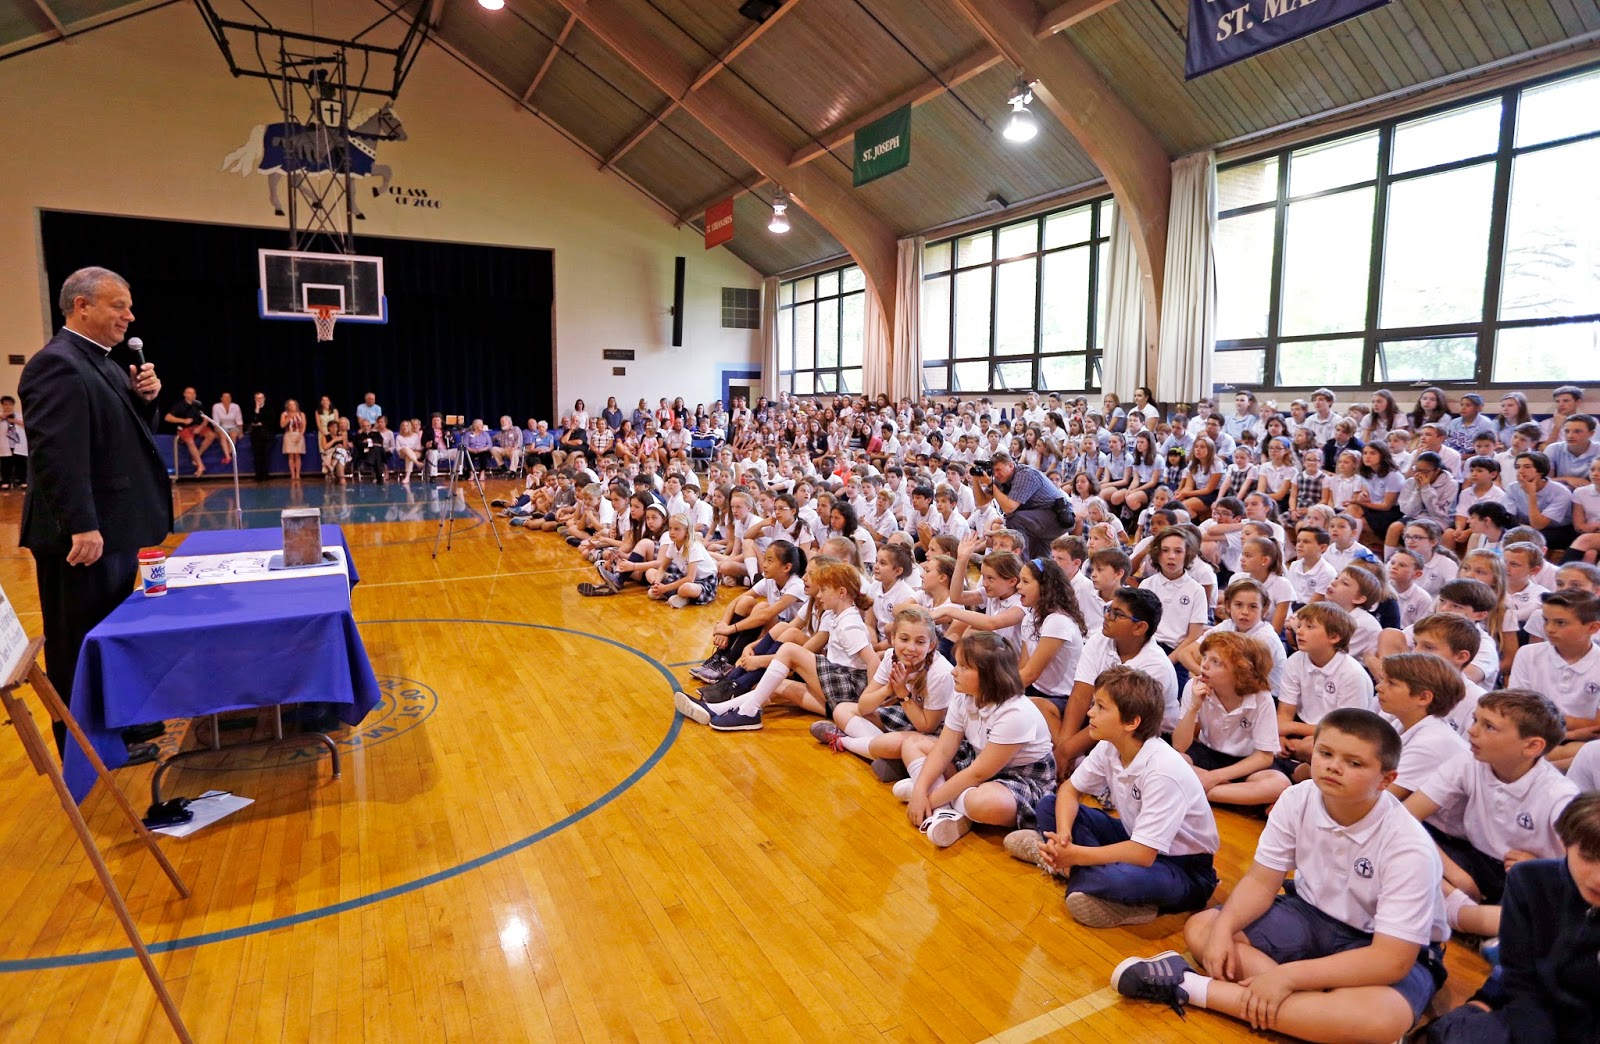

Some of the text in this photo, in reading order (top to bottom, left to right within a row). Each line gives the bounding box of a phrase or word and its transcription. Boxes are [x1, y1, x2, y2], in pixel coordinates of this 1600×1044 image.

[1216, 5, 1254, 42] ST.
[863, 136, 900, 162] ST. JOSEPH
[389, 186, 428, 198] CLASS
[396, 196, 442, 209] OF 2000
[400, 689, 426, 701] OF
